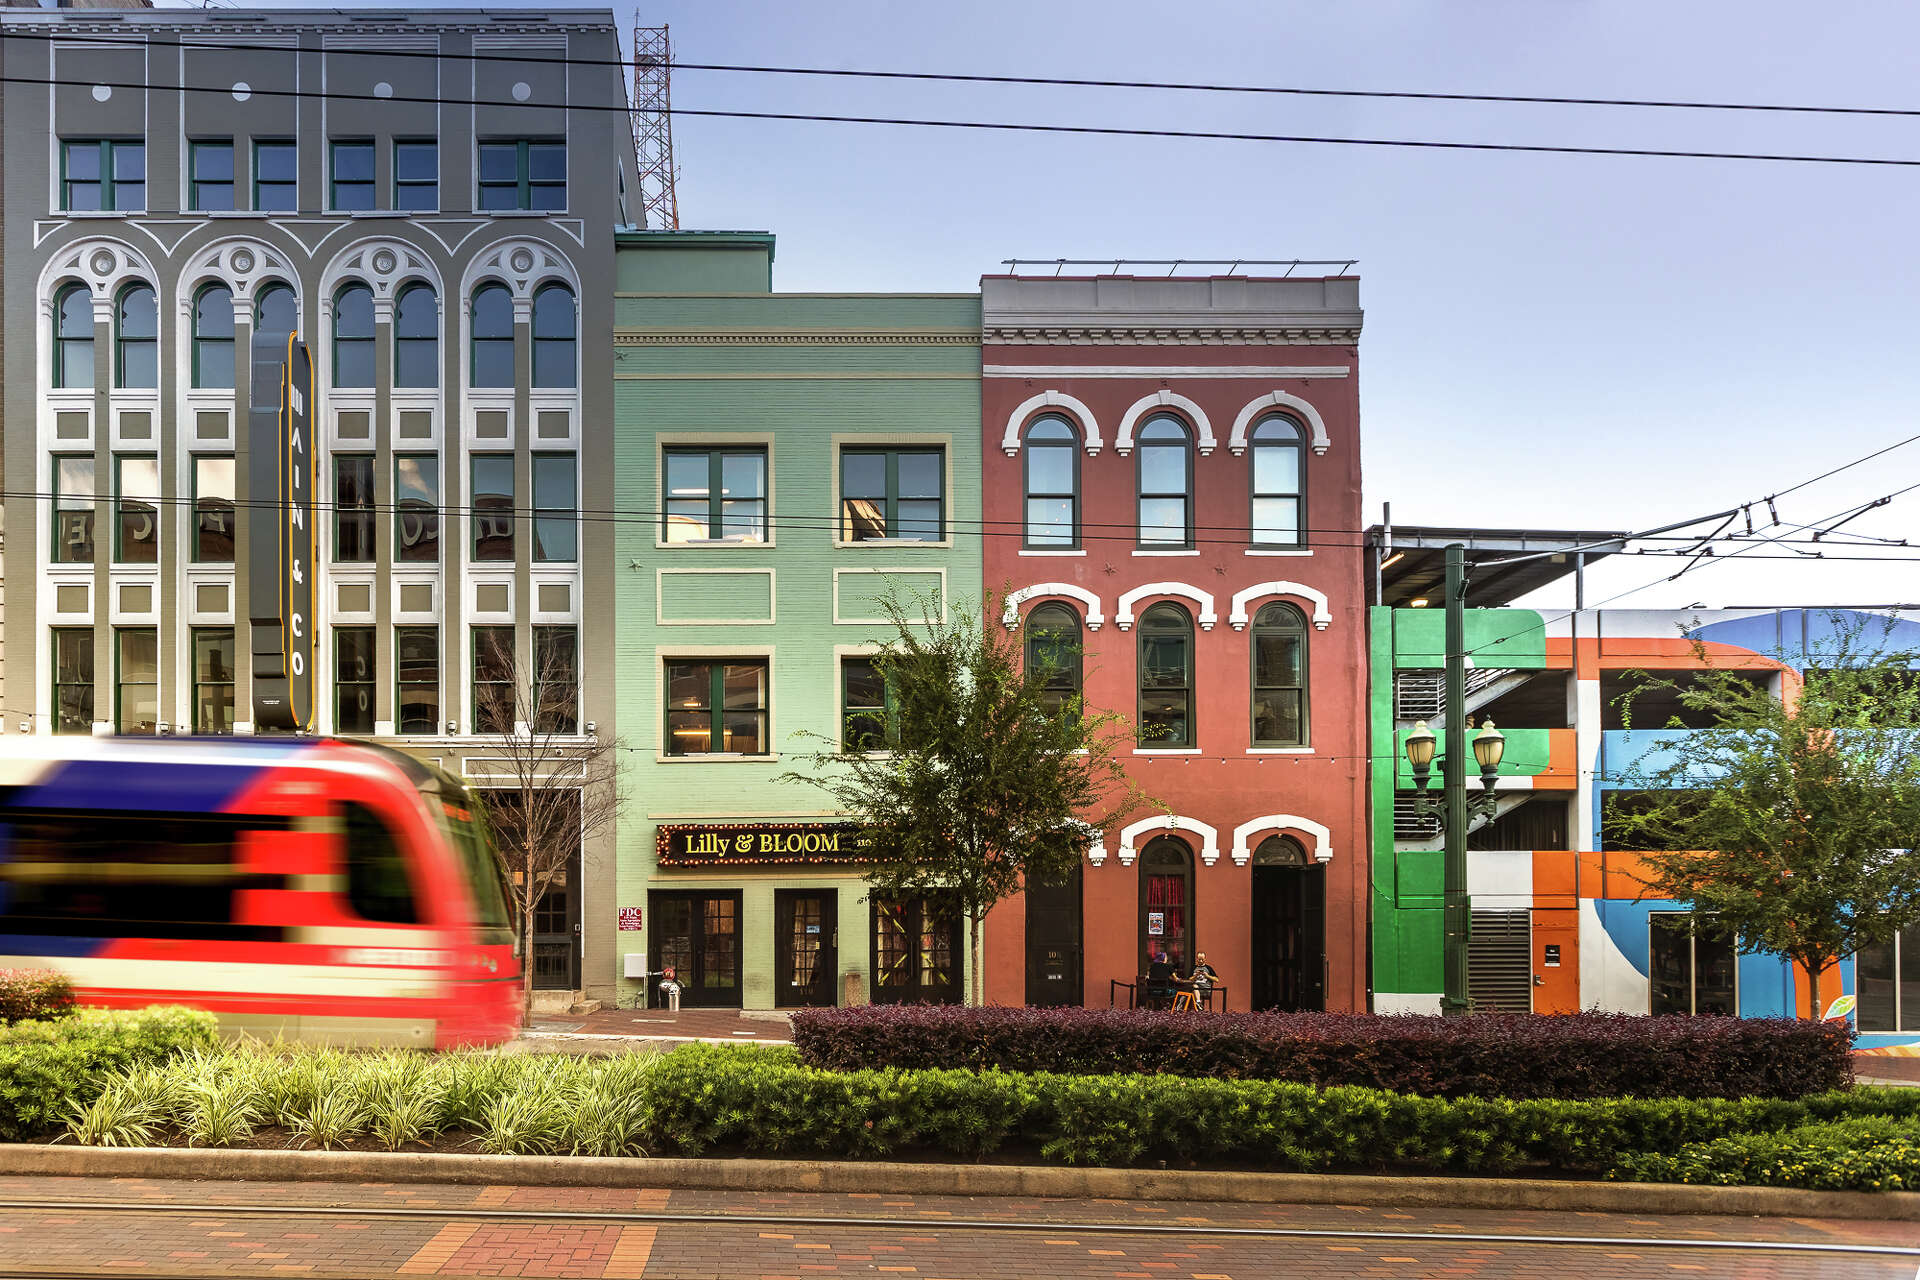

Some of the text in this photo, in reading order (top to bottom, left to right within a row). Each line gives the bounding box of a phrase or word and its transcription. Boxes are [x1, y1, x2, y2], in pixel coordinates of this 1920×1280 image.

[293, 559, 303, 584] &
[292, 613, 303, 675] CO
[685, 833, 731, 857] Lilly
[735, 834, 755, 853] &
[759, 833, 839, 852] BLOOM
[620, 907, 641, 917] FDC
